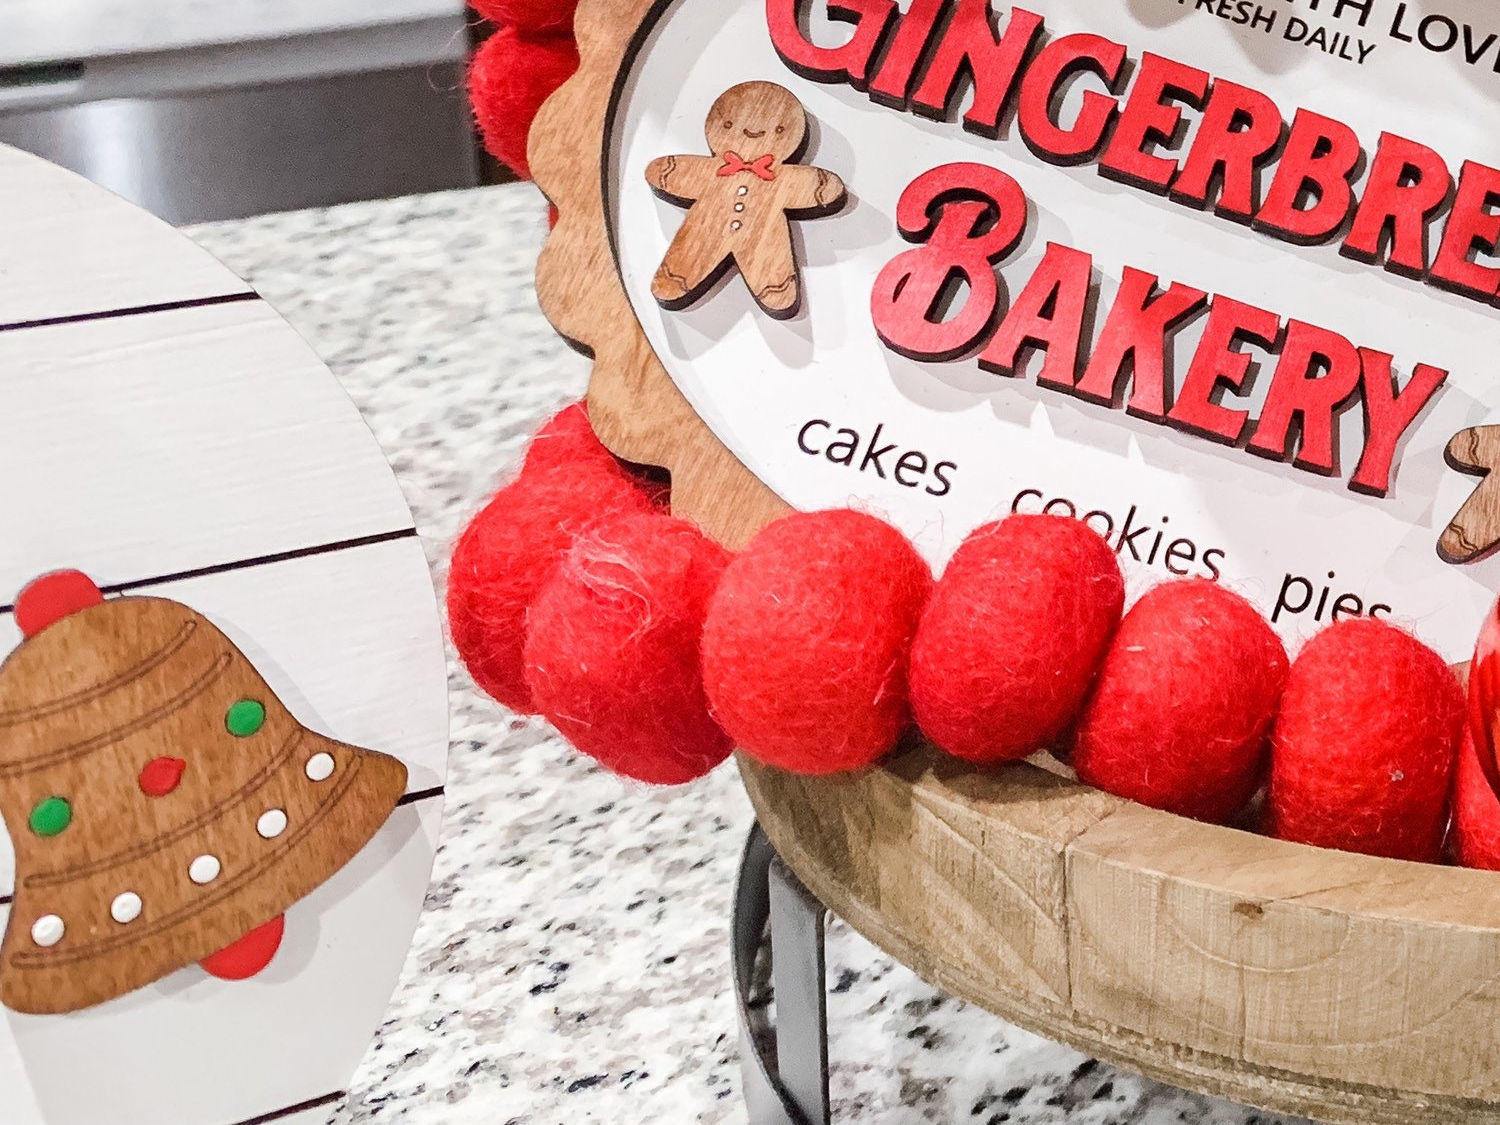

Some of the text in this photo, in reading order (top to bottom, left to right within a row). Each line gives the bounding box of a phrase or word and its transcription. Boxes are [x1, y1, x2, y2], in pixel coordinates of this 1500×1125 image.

[1283, 15, 1377, 66] DAILY
[870, 161, 1448, 499] BAKERY
[796, 412, 959, 498] cakes
